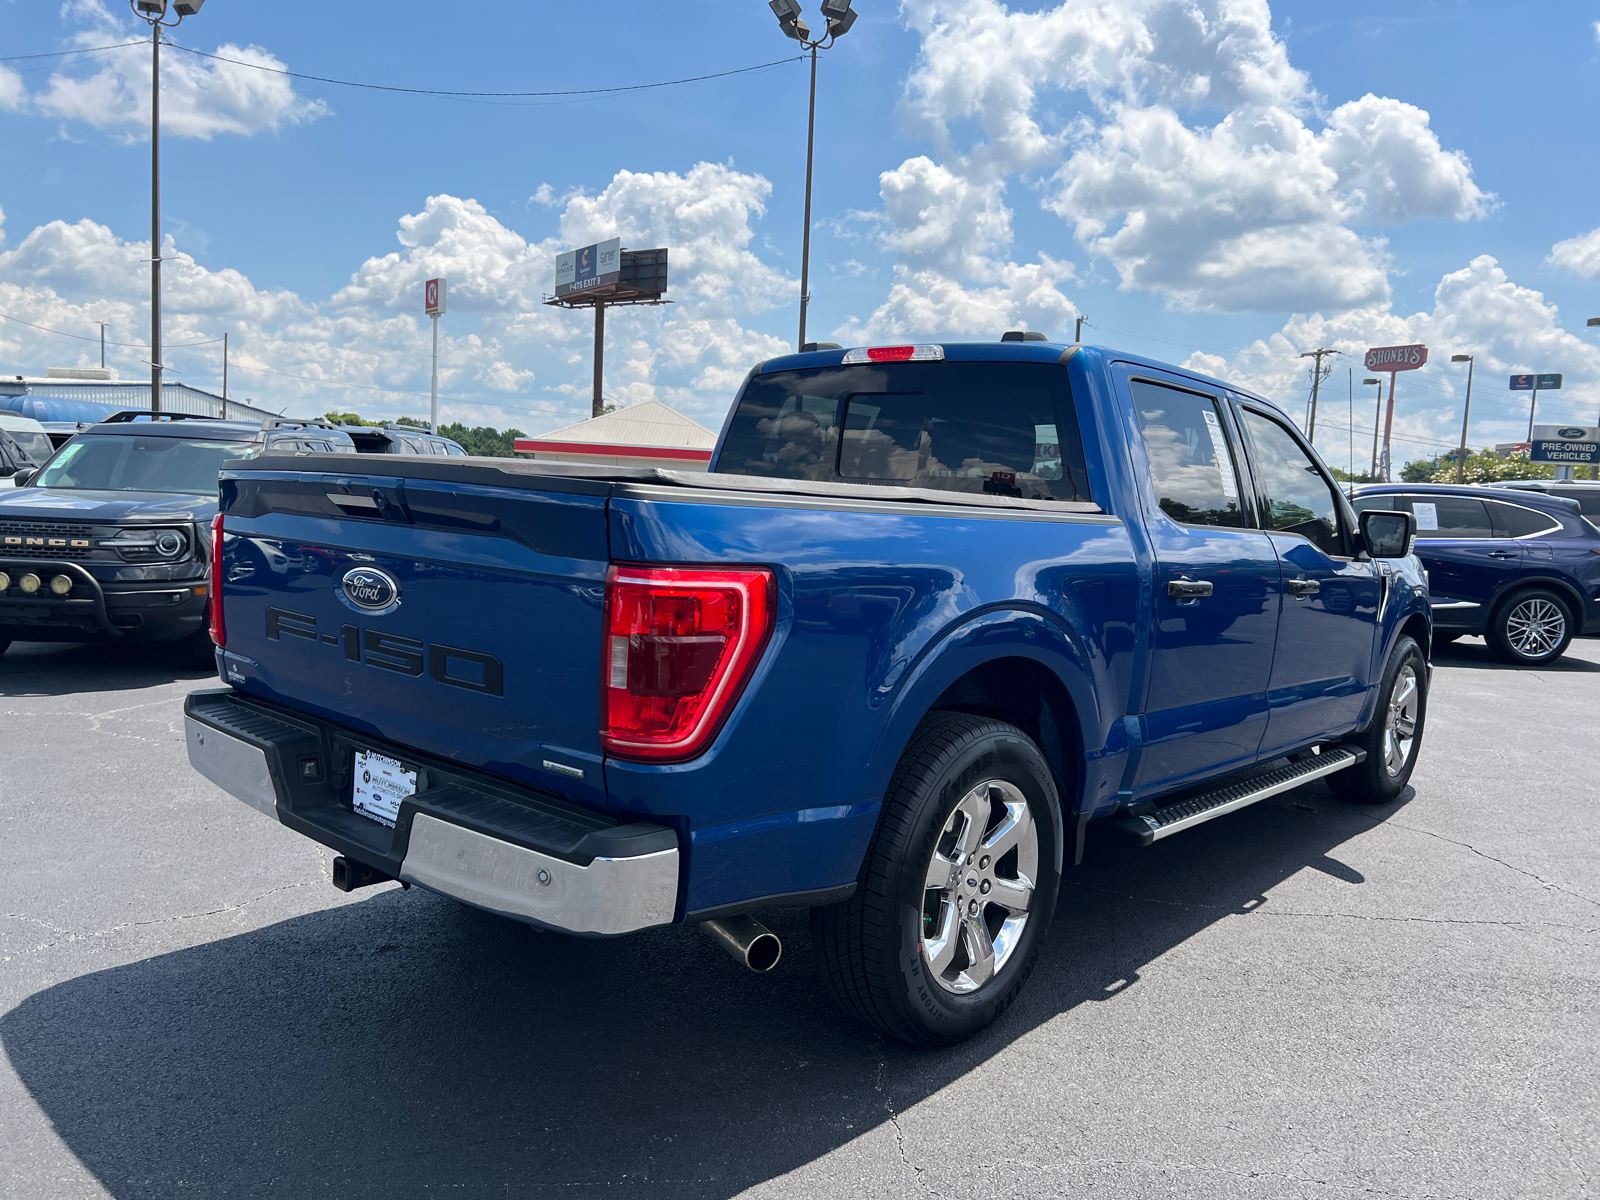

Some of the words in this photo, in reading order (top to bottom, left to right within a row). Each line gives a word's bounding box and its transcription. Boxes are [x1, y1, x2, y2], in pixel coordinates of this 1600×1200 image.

[583, 277, 597, 288] EXIT
[596, 276, 601, 285] 9
[1367, 347, 1421, 367] SHONEY'S
[1541, 442, 1597, 452] PRE-OWNED
[1546, 452, 1592, 461] VEHICLES
[350, 575, 381, 602] Ford
[266, 606, 504, 698] F-150
[371, 751, 402, 768] HUTCHINSON
